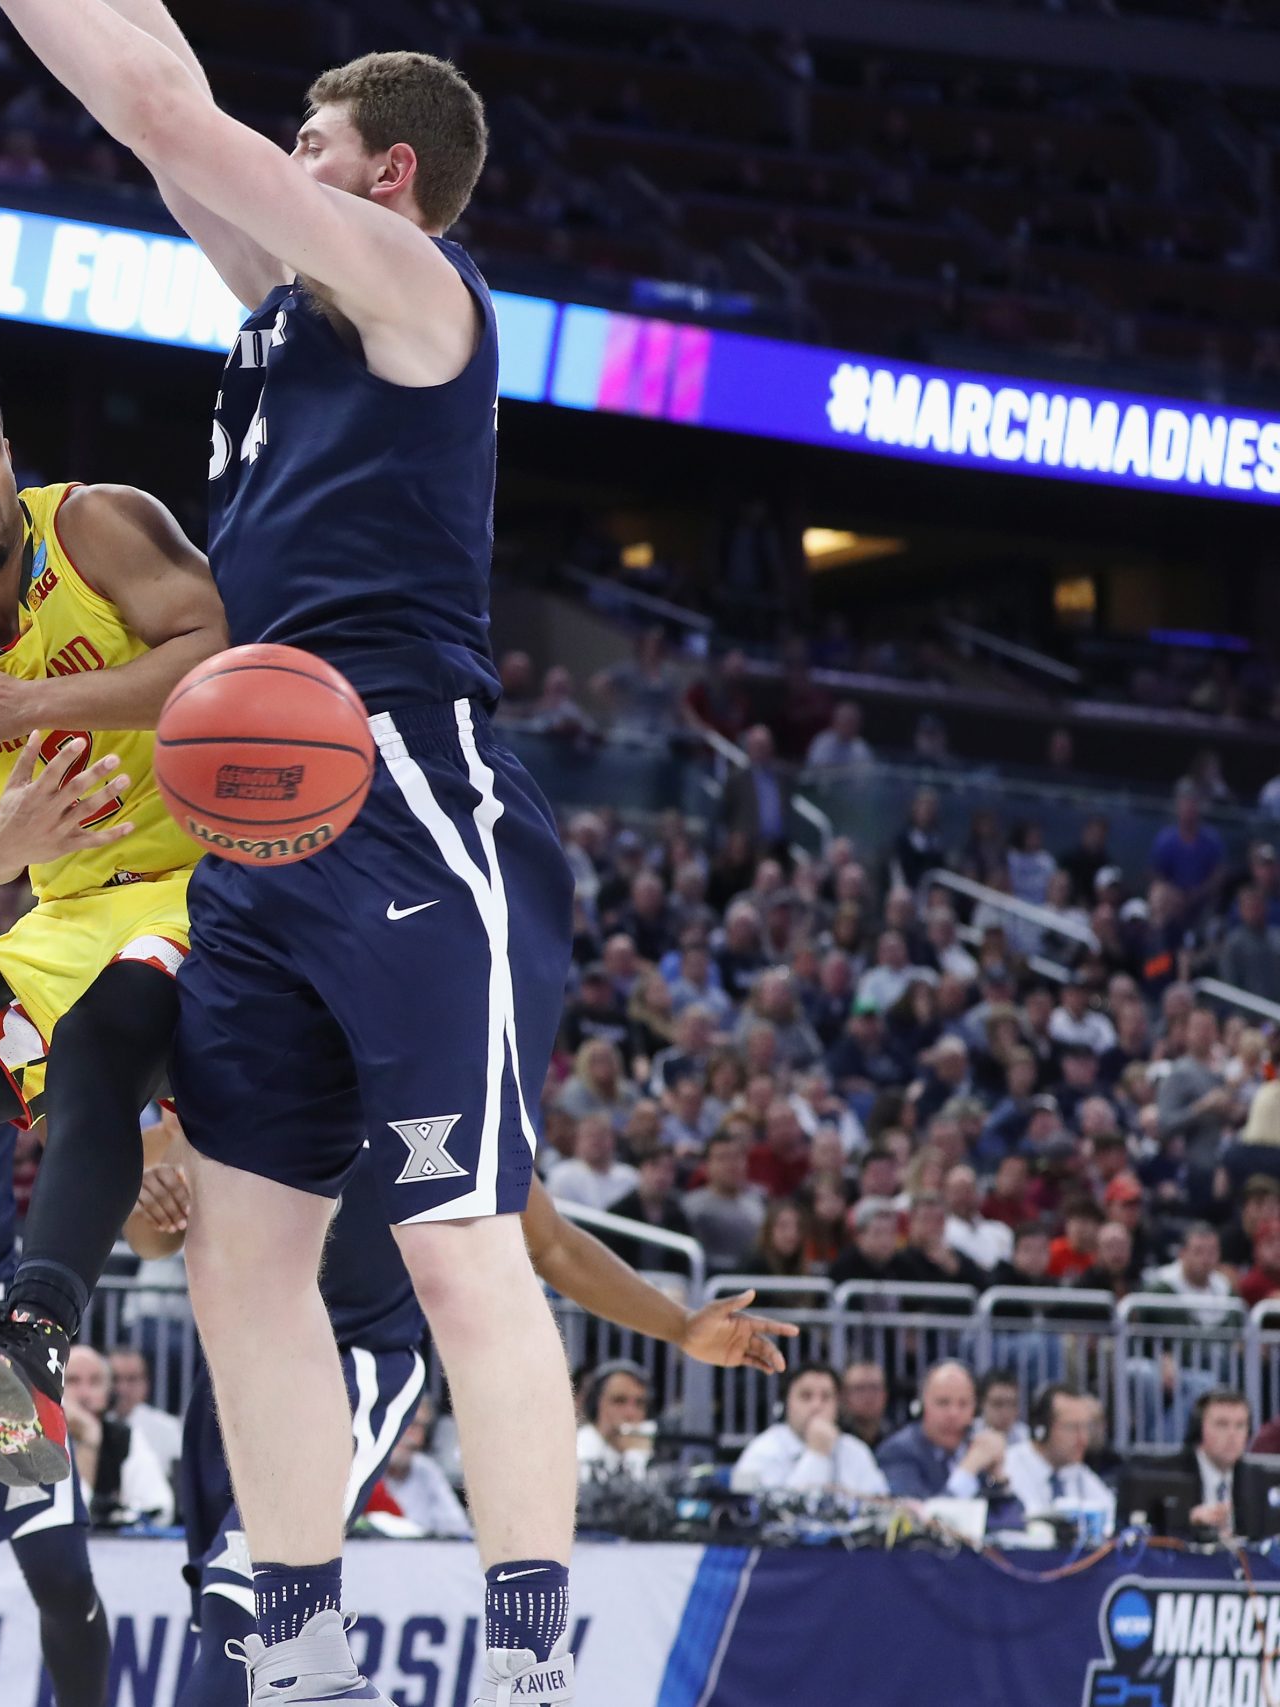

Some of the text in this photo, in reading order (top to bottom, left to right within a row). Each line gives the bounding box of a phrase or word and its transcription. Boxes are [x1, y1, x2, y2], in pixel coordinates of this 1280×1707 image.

[39, 729, 124, 829] 2
[186, 816, 335, 859] Wilson
[513, 1669, 567, 1695] XAVIER
